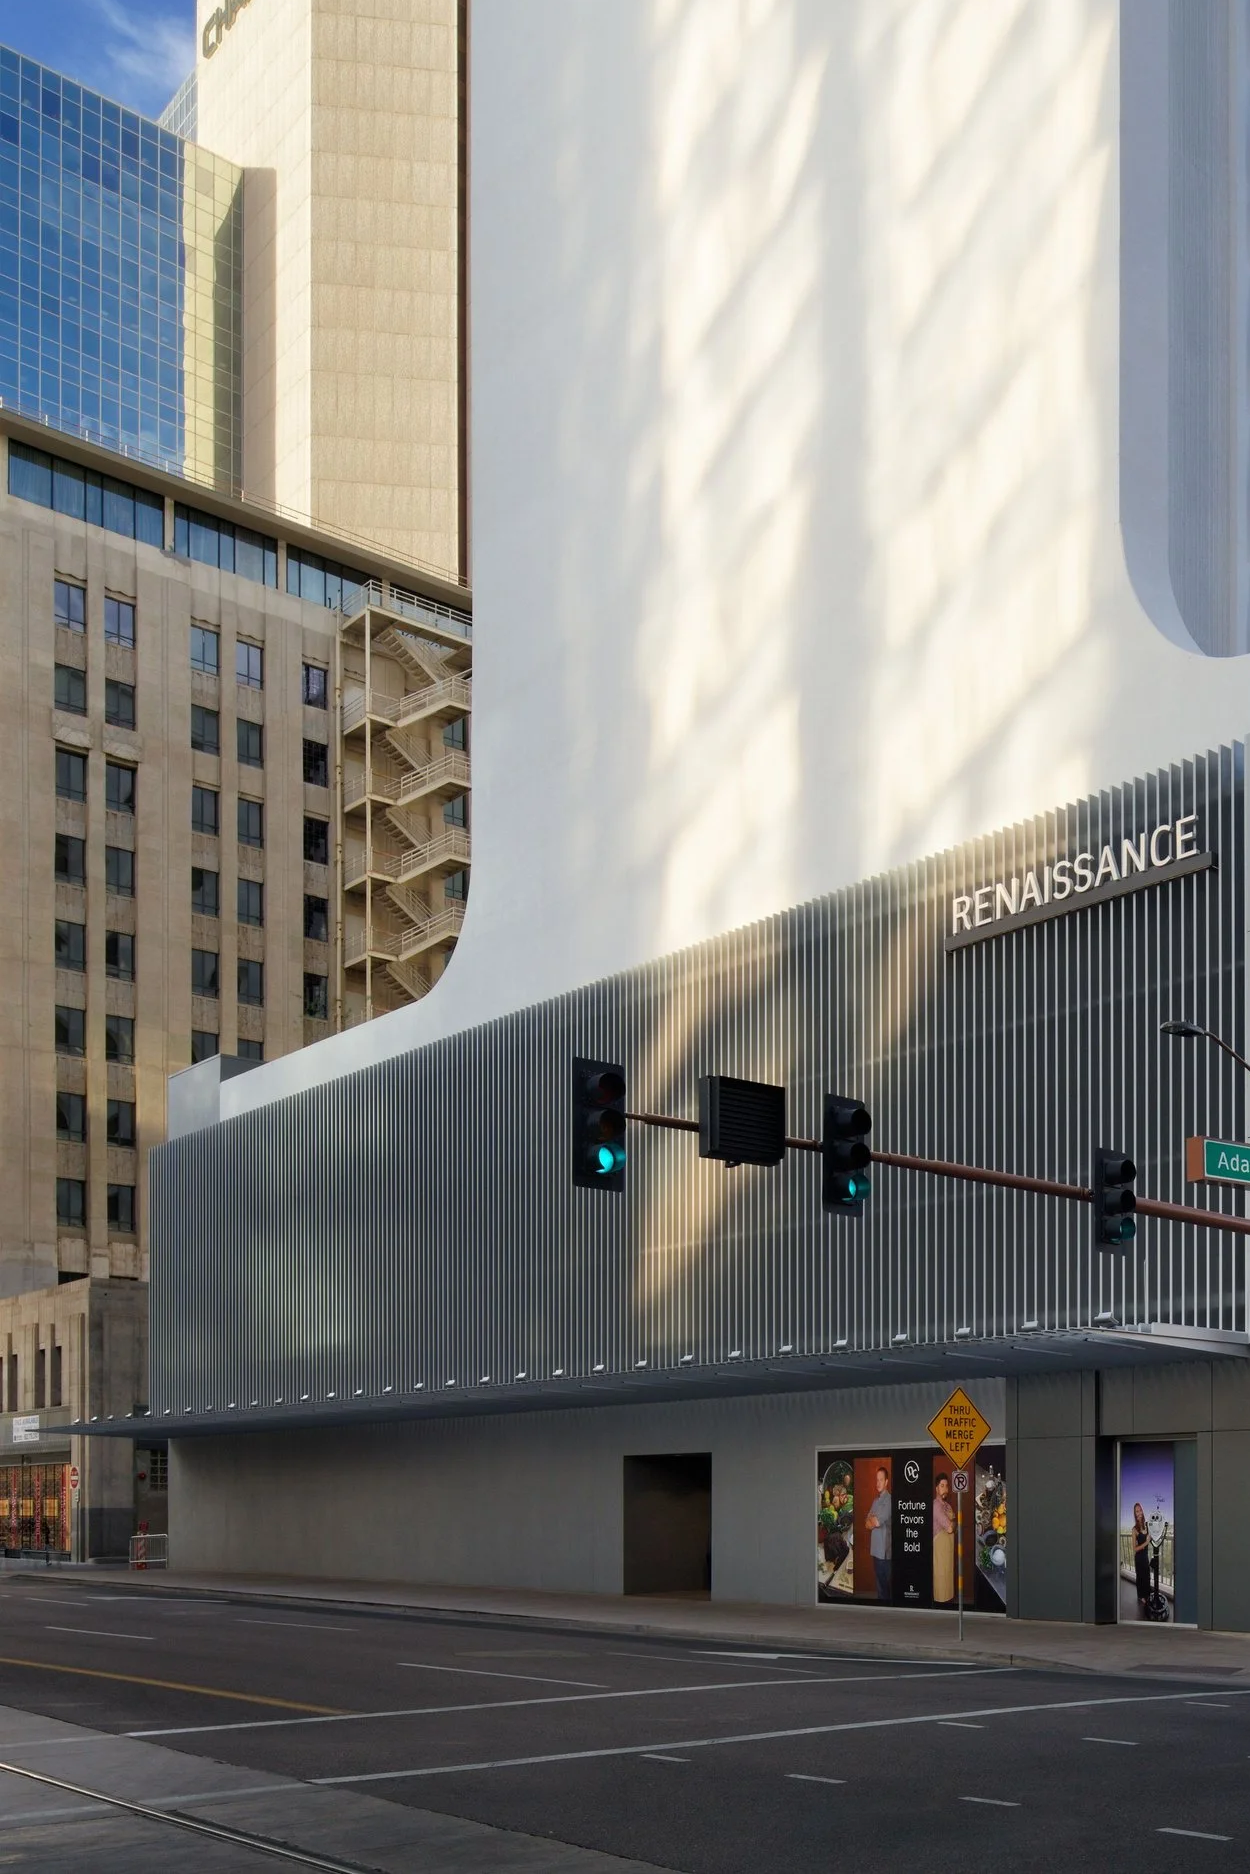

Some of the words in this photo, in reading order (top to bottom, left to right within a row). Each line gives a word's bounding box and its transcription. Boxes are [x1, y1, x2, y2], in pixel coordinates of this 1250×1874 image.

[952, 814, 1199, 935] RENAISSANCE
[949, 1405, 971, 1415] THRU
[943, 1417, 976, 1427] TRAFFIC
[945, 1430, 974, 1439] MERGE
[949, 1442, 971, 1452] LEFT
[898, 1500, 926, 1510] Fortune
[900, 1514, 924, 1524] Favors
[905, 1528, 918, 1538] the
[903, 1542, 920, 1552] Bold
